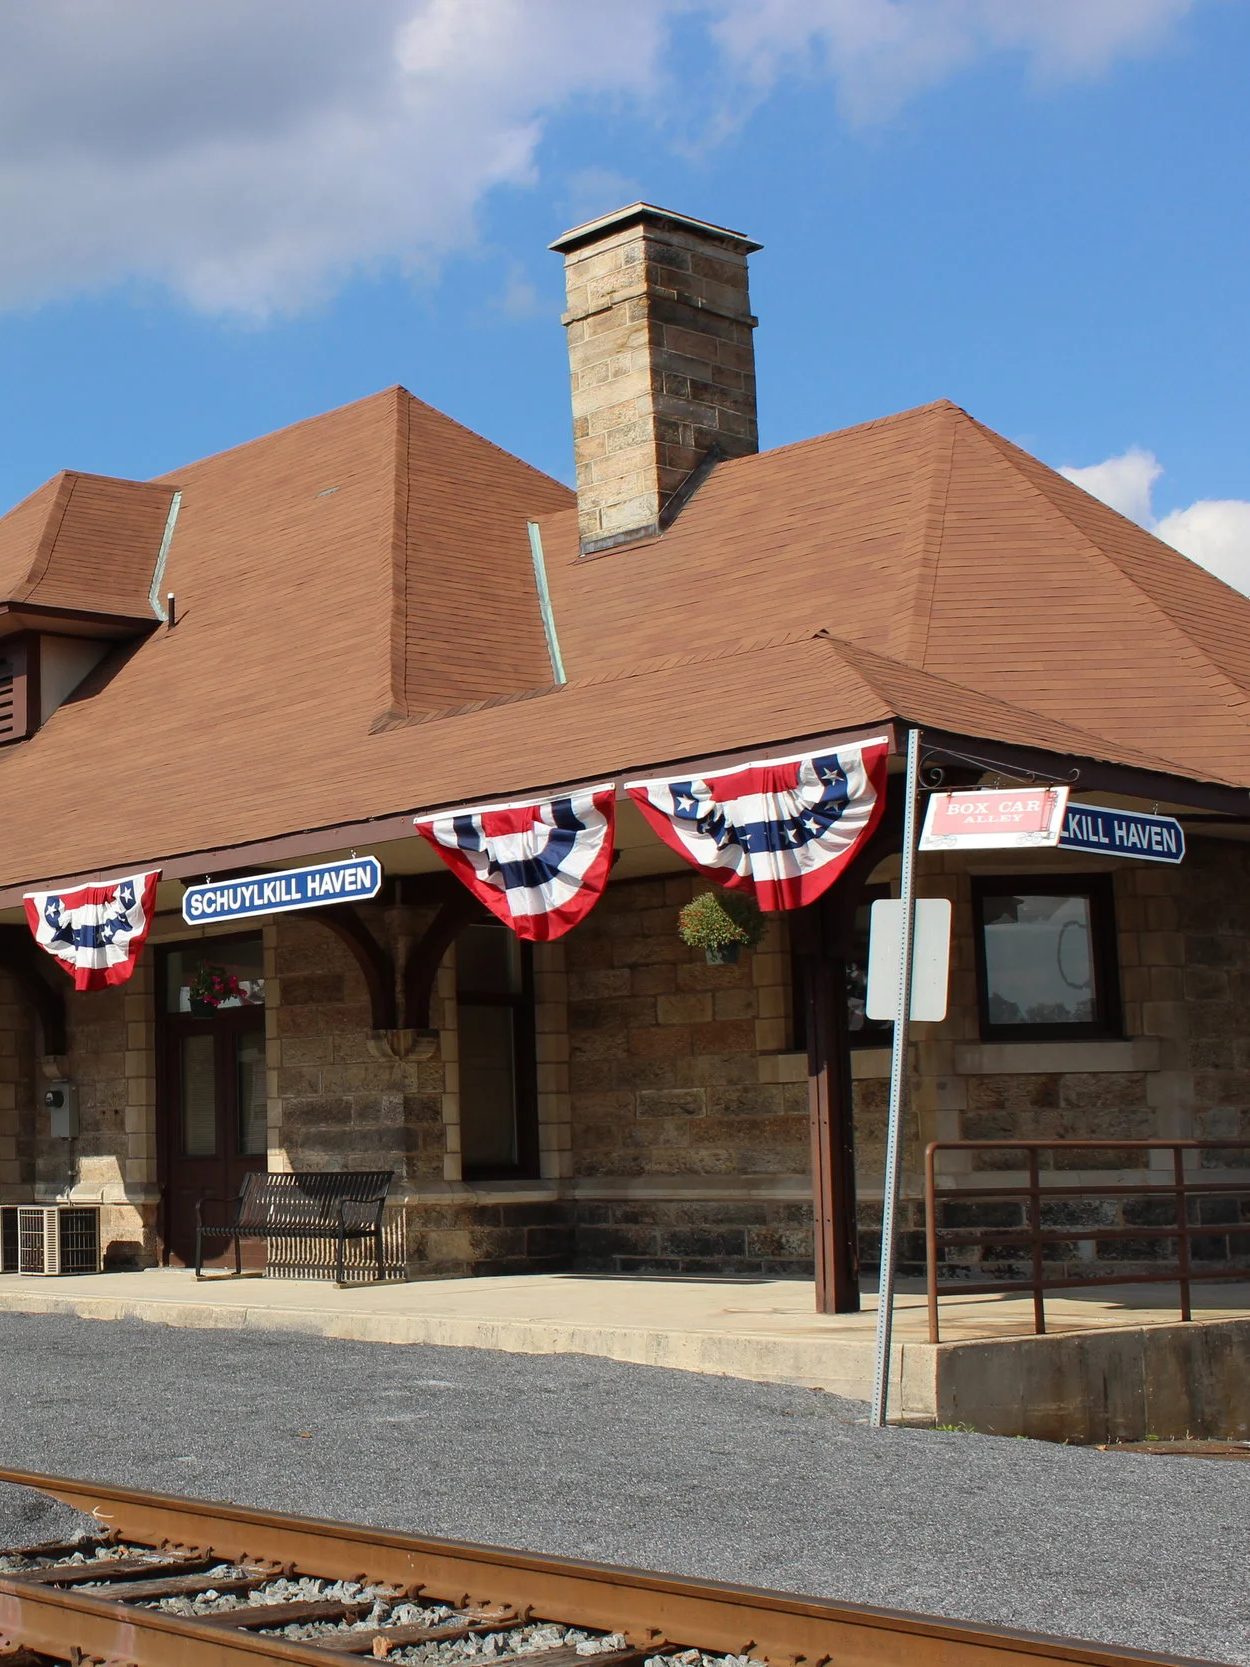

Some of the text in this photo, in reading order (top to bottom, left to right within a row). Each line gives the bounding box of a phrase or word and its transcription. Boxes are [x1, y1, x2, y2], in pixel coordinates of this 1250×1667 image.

[946, 800, 1040, 815] BOX CAR
[963, 814, 1024, 824] ALLEY
[1114, 820, 1176, 853] HAVEN
[190, 865, 371, 916] SCHUYLKILL HAVEN
